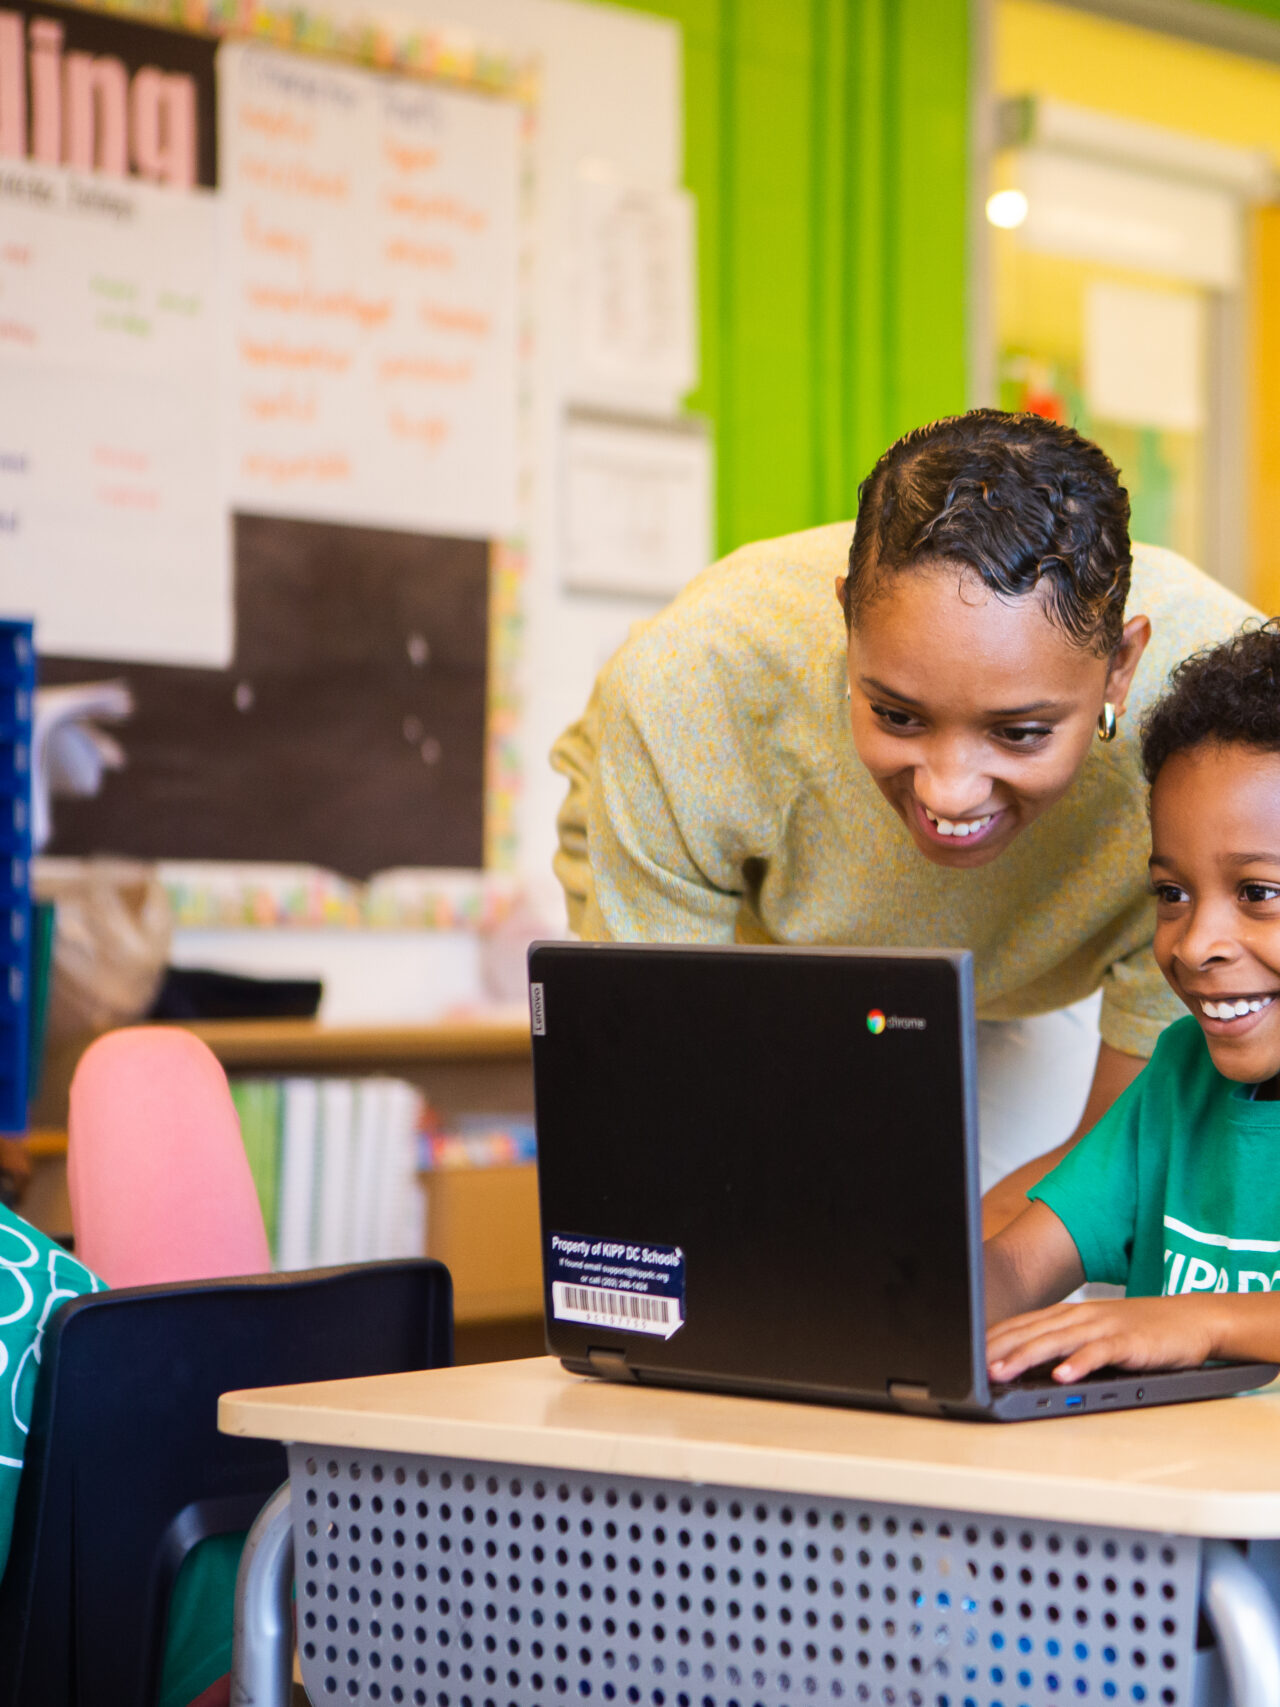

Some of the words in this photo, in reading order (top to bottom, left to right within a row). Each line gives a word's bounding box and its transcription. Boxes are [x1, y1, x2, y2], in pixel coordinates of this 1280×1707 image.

[887, 1014, 927, 1030] chrome
[552, 1236, 590, 1257] Property
[591, 1242, 602, 1255] of
[602, 1243, 626, 1259] KIPP
[626, 1246, 641, 1262] DC
[641, 1248, 680, 1267] Schools
[559, 1258, 565, 1266] If
[564, 1258, 583, 1270] found
[583, 1262, 602, 1272] email
[1161, 1249, 1229, 1297] IP
[588, 1275, 601, 1284] call
